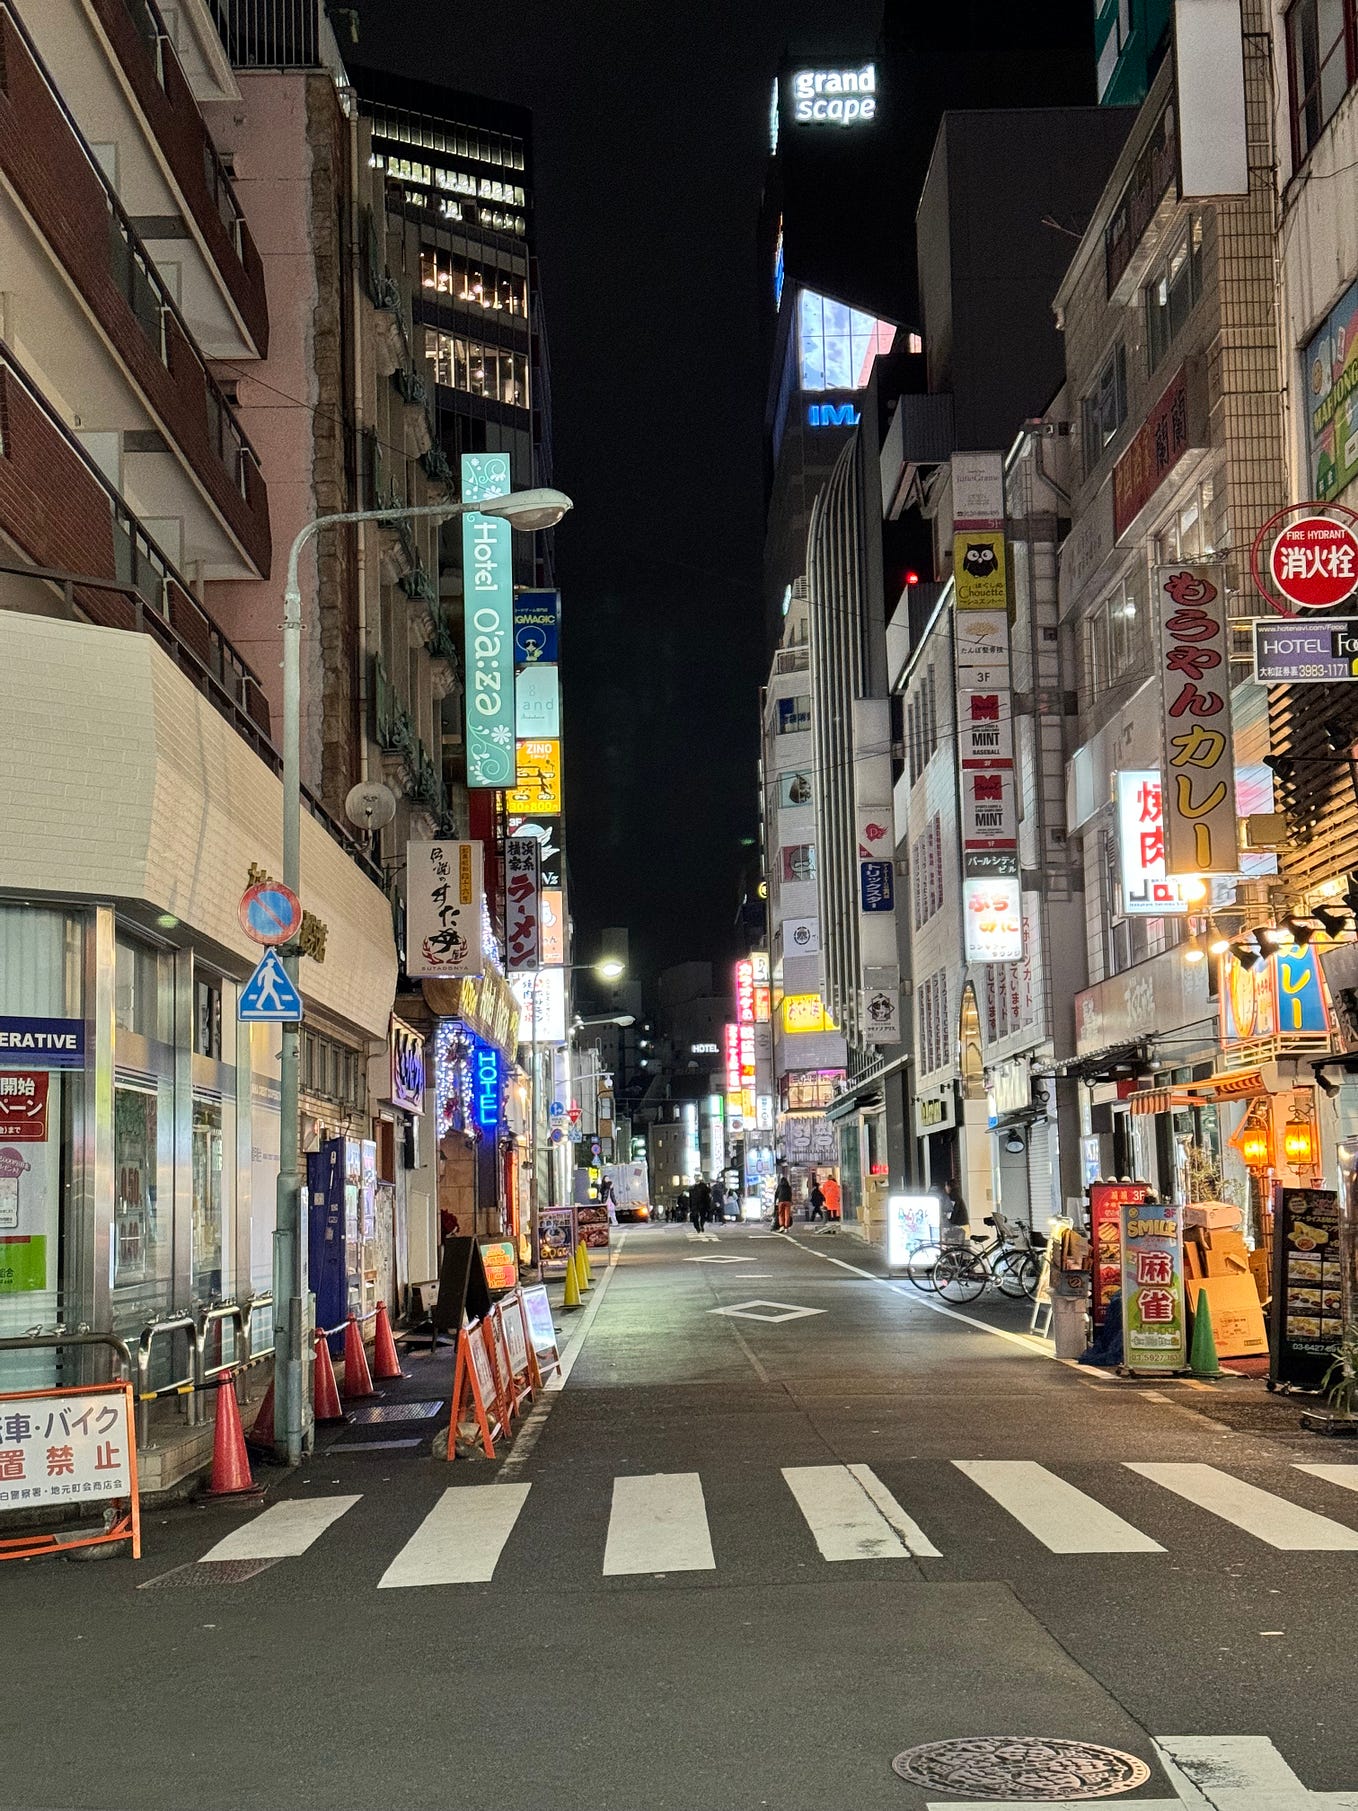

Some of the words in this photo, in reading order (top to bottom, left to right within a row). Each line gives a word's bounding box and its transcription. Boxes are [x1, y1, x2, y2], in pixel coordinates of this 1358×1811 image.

[797, 64, 876, 97] grand
[798, 98, 876, 124] scape
[808, 403, 862, 427] IM
[1287, 531, 1305, 541] FIRE
[1307, 529, 1346, 541] HYDRANT
[474, 521, 498, 591] Hotel
[1280, 544, 1356, 580] 消火栓
[958, 585, 1004, 599] Chouette
[1264, 639, 1330, 655] HOTEL
[976, 672, 991, 682] 3F
[1298, 663, 1349, 678] 3983-1171
[523, 698, 554, 711] and
[1163, 571, 1228, 869] もうやんカレー
[972, 732, 1000, 746] MINT
[526, 743, 552, 754] ZINO
[508, 817, 523, 827] 3F
[975, 812, 1003, 826] MINT
[507, 841, 535, 856] 横浜
[507, 857, 535, 872] 家系
[507, 873, 536, 967] ラーメン
[1009, 963, 1020, 1018] ています
[0, 1032, 77, 1049] ERATIVE
[691, 1043, 719, 1053] HOTEL
[0, 1077, 35, 1096] 開始
[478, 1051, 498, 1124] HOTEL
[1133, 1189, 1146, 1201] 3F
[1163, 1208, 1177, 1219] 3F
[1127, 1219, 1177, 1238] SMILE
[1137, 1250, 1175, 1323] 麻雀
[0, 1405, 119, 1444] 車・バイク
[0, 1440, 122, 1481] 置禁止
